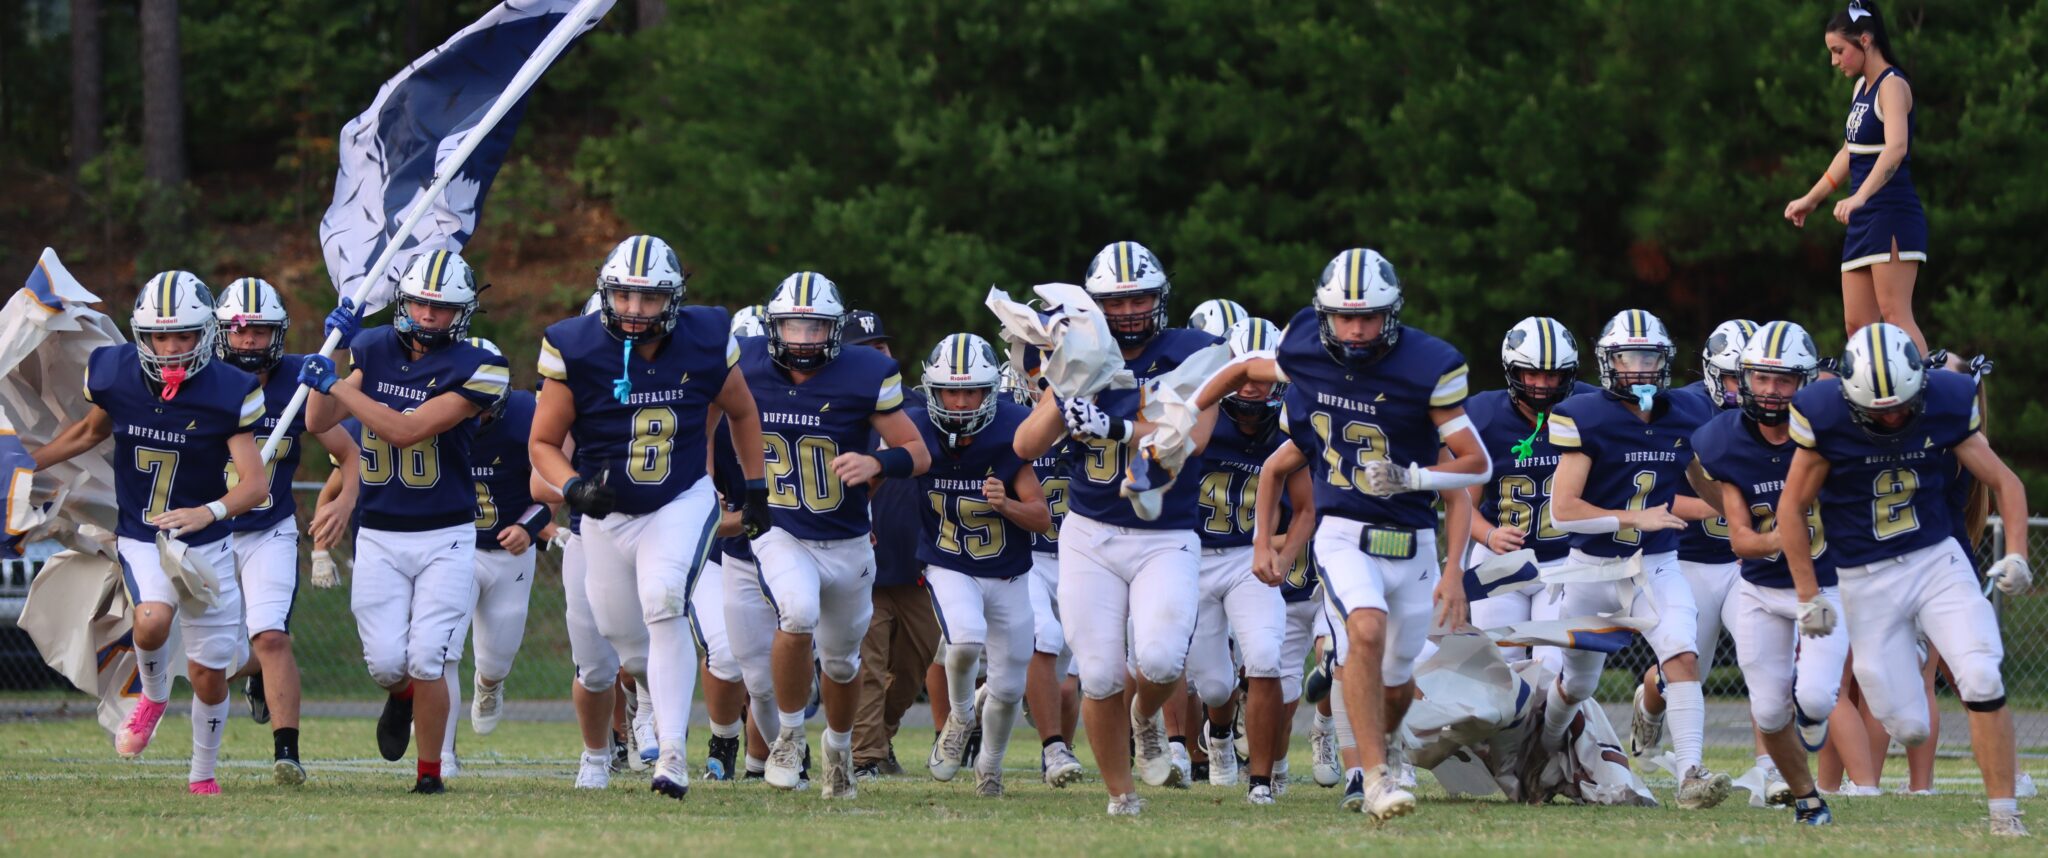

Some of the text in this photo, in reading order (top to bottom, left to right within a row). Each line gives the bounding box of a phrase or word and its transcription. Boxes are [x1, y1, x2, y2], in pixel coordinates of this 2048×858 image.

[420, 290, 442, 299] Riddell
[376, 381, 427, 401] BUFFALOES
[1317, 392, 1376, 415] BUFFALOES
[128, 424, 187, 444] BUFFALOES
[763, 412, 821, 426] BUFFALOES
[359, 403, 441, 489] 98
[625, 405, 678, 485] 8
[1310, 410, 1393, 499] 13
[1514, 455, 1563, 468] BUFFALO
[1624, 451, 1676, 462] BUFFALOES
[134, 445, 179, 525] 7
[761, 431, 844, 514] 20
[1754, 480, 1786, 494] BUFFA
[927, 489, 1006, 560] 15
[1612, 469, 1657, 546] 1
[1872, 467, 1920, 541] 2
